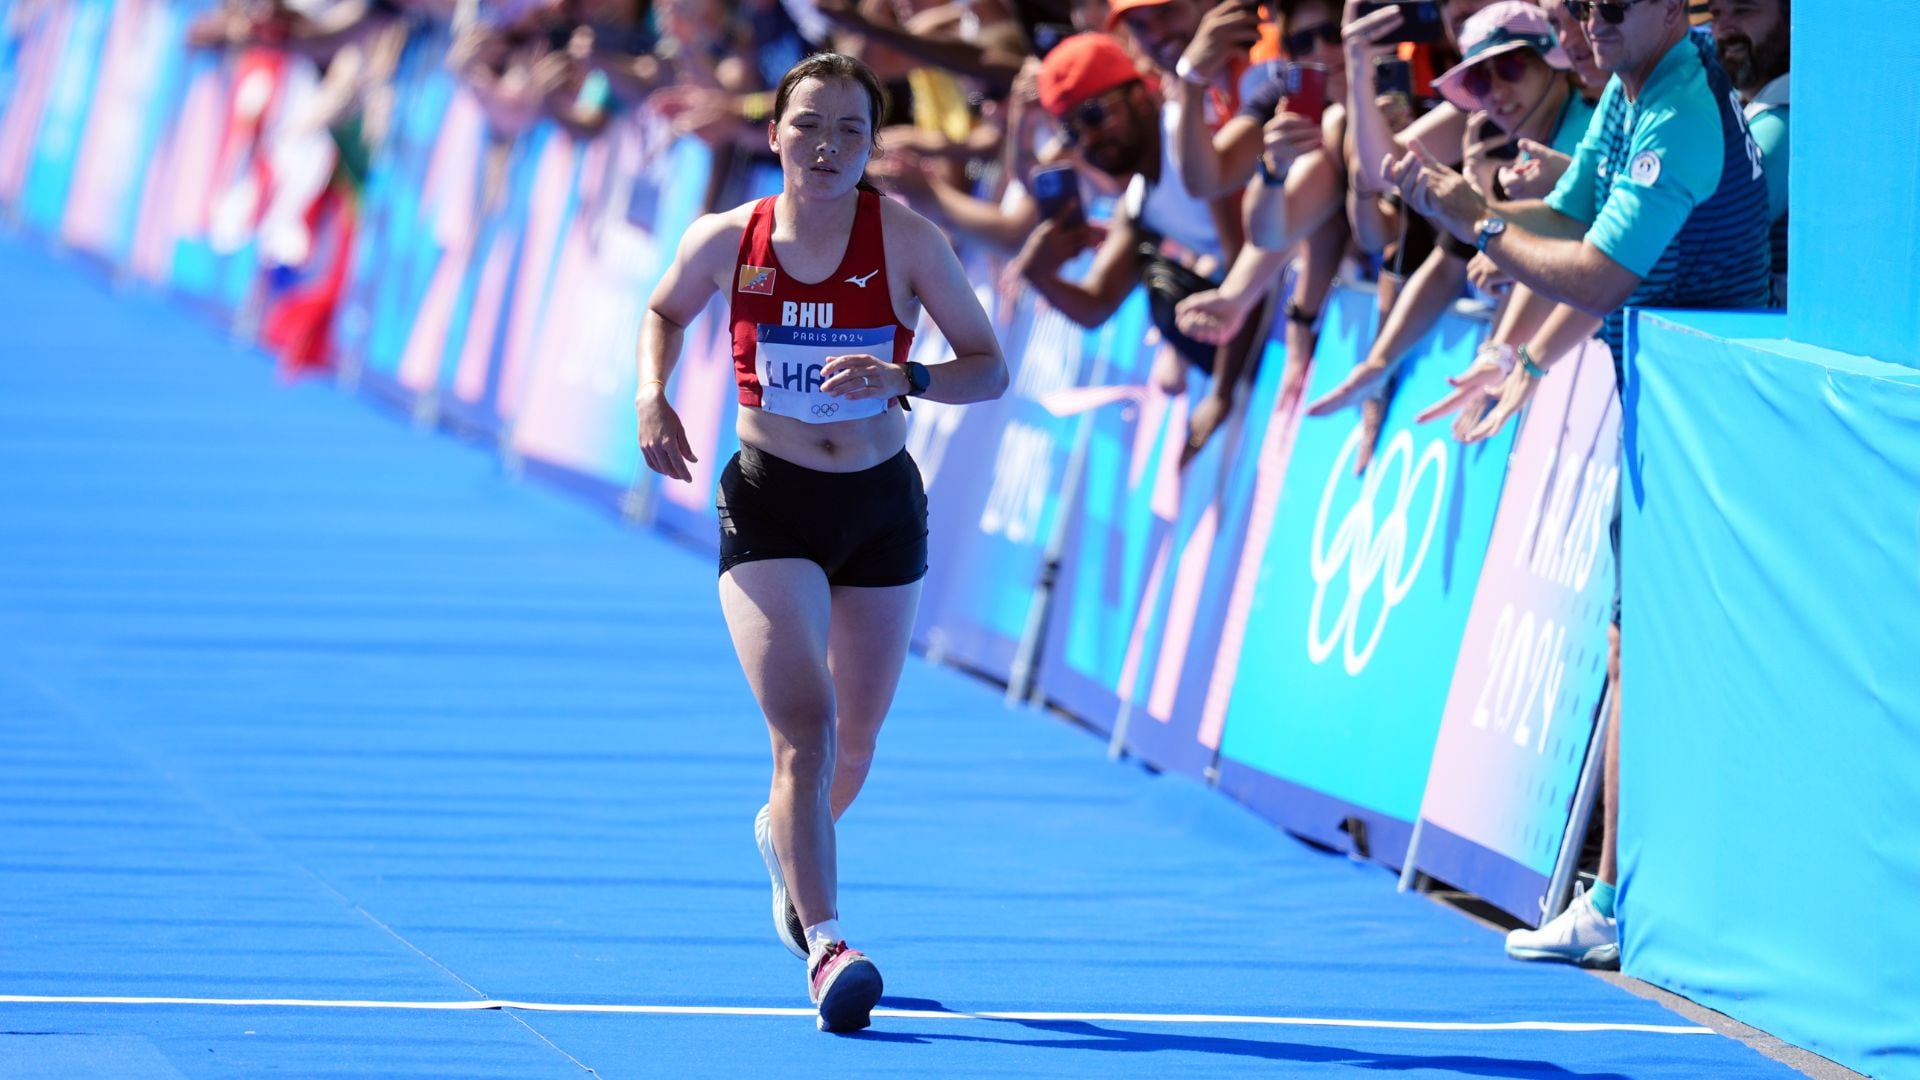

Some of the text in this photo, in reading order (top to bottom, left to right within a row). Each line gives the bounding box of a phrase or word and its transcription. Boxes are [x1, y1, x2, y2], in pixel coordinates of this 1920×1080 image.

[782, 301, 833, 328] BHU
[793, 332, 864, 343] PARIS 2024
[1472, 602, 1566, 754] 2024
